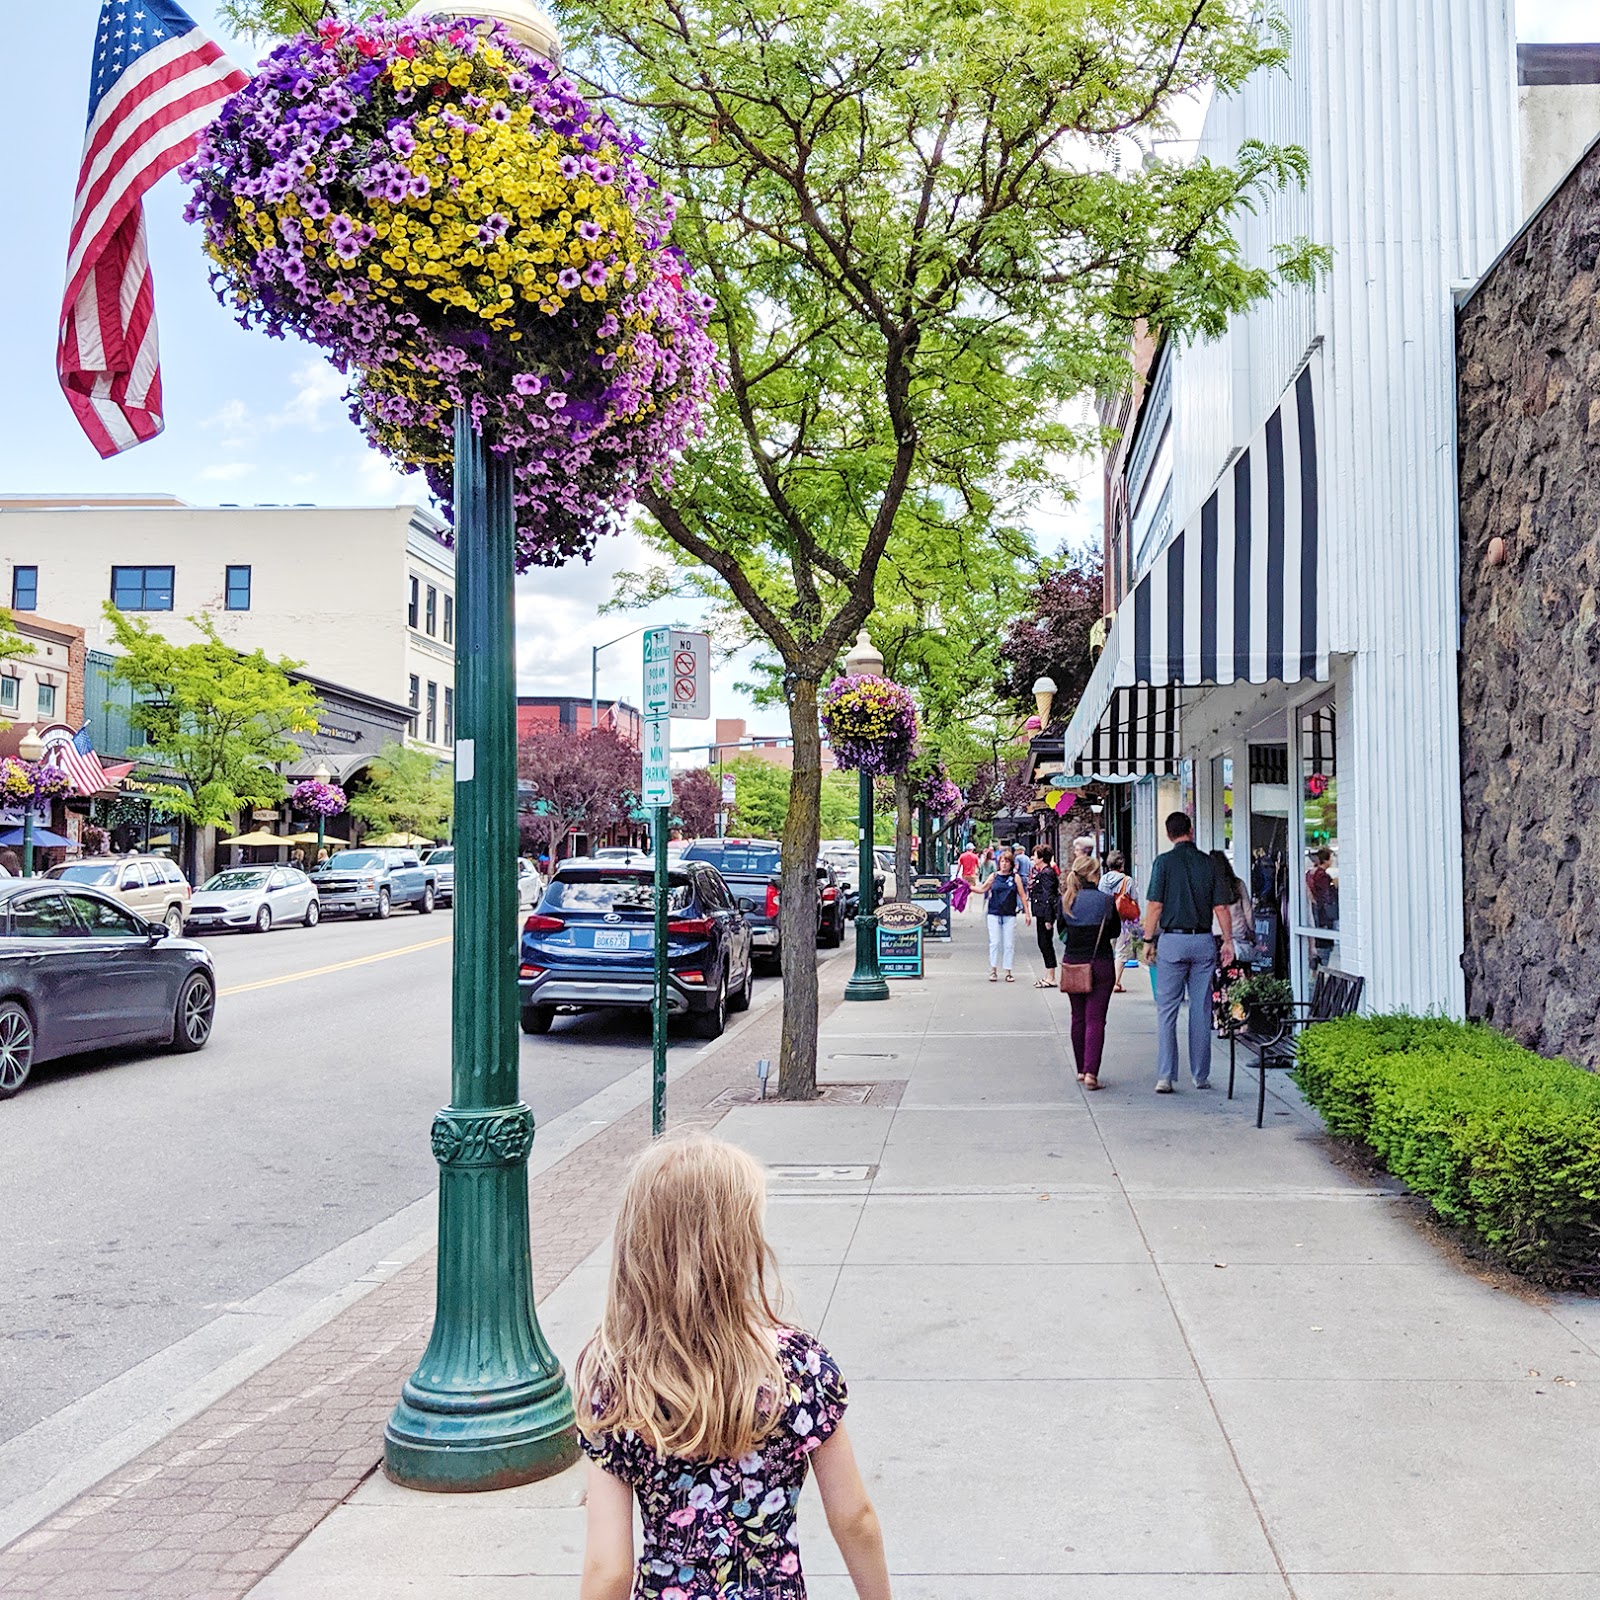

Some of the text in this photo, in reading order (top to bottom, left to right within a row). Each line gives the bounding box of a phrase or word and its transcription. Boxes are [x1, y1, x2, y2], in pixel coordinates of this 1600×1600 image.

[644, 639, 652, 660] 2
[652, 646, 670, 658] PARKING
[680, 640, 692, 650] NO
[650, 746, 663, 762] MIN
[645, 766, 668, 782] PARKING
